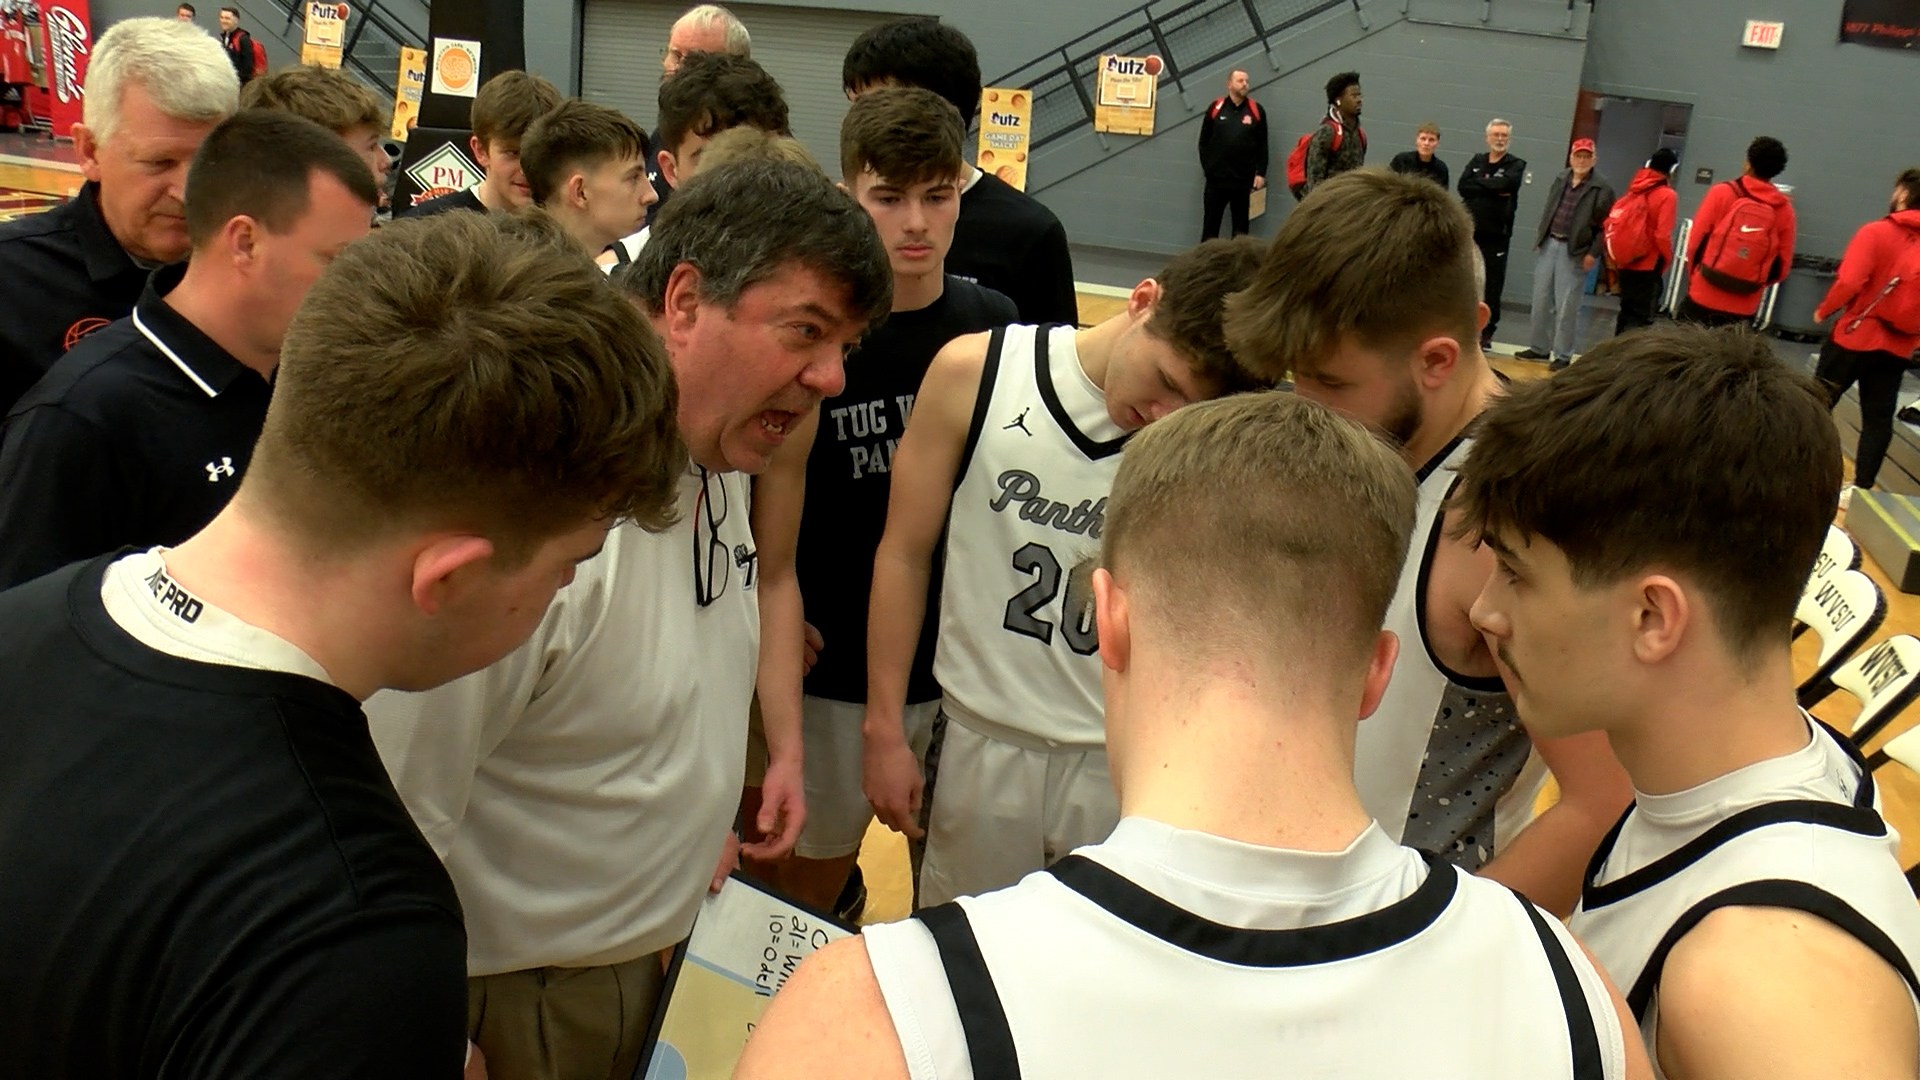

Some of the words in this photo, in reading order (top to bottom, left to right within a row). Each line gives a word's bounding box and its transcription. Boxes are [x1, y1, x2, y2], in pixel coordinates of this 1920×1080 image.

[1751, 24, 1778, 45] EXIT
[432, 166, 464, 188] PM
[830, 398, 887, 441] TUG
[160, 582, 204, 624] PRO
[1003, 541, 1101, 656] 20
[1814, 579, 1857, 632] WVSU
